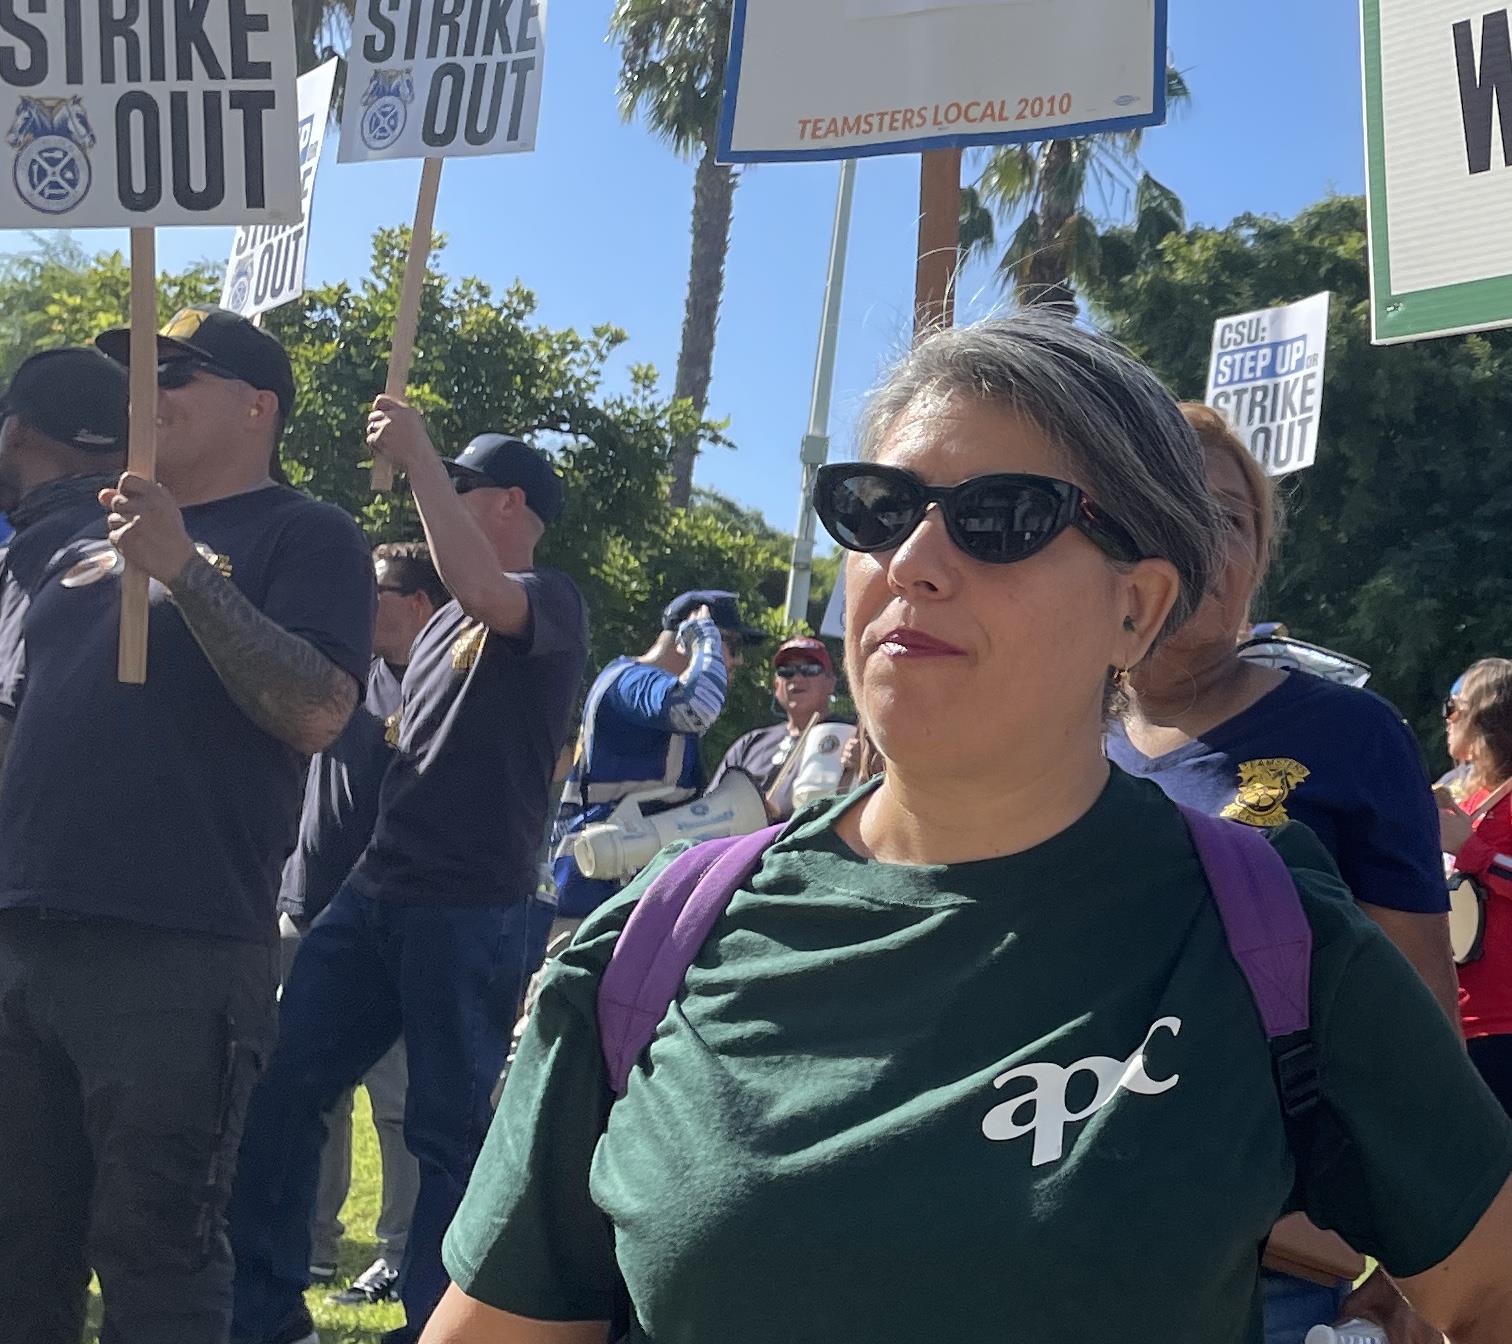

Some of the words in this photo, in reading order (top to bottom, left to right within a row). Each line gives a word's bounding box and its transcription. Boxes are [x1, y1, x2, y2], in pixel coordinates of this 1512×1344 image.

[421, 56, 536, 148] OUT
[798, 106, 928, 141] TEAMSTERS
[932, 98, 1010, 128] LOCAL
[1015, 92, 1073, 121] 2010
[115, 89, 276, 212] OUT
[254, 227, 304, 306] OUT
[1217, 348, 1271, 385] STEP
[1275, 340, 1304, 375] UP
[1219, 317, 1267, 349] CSU:
[981, 1016, 1182, 1167] apc
